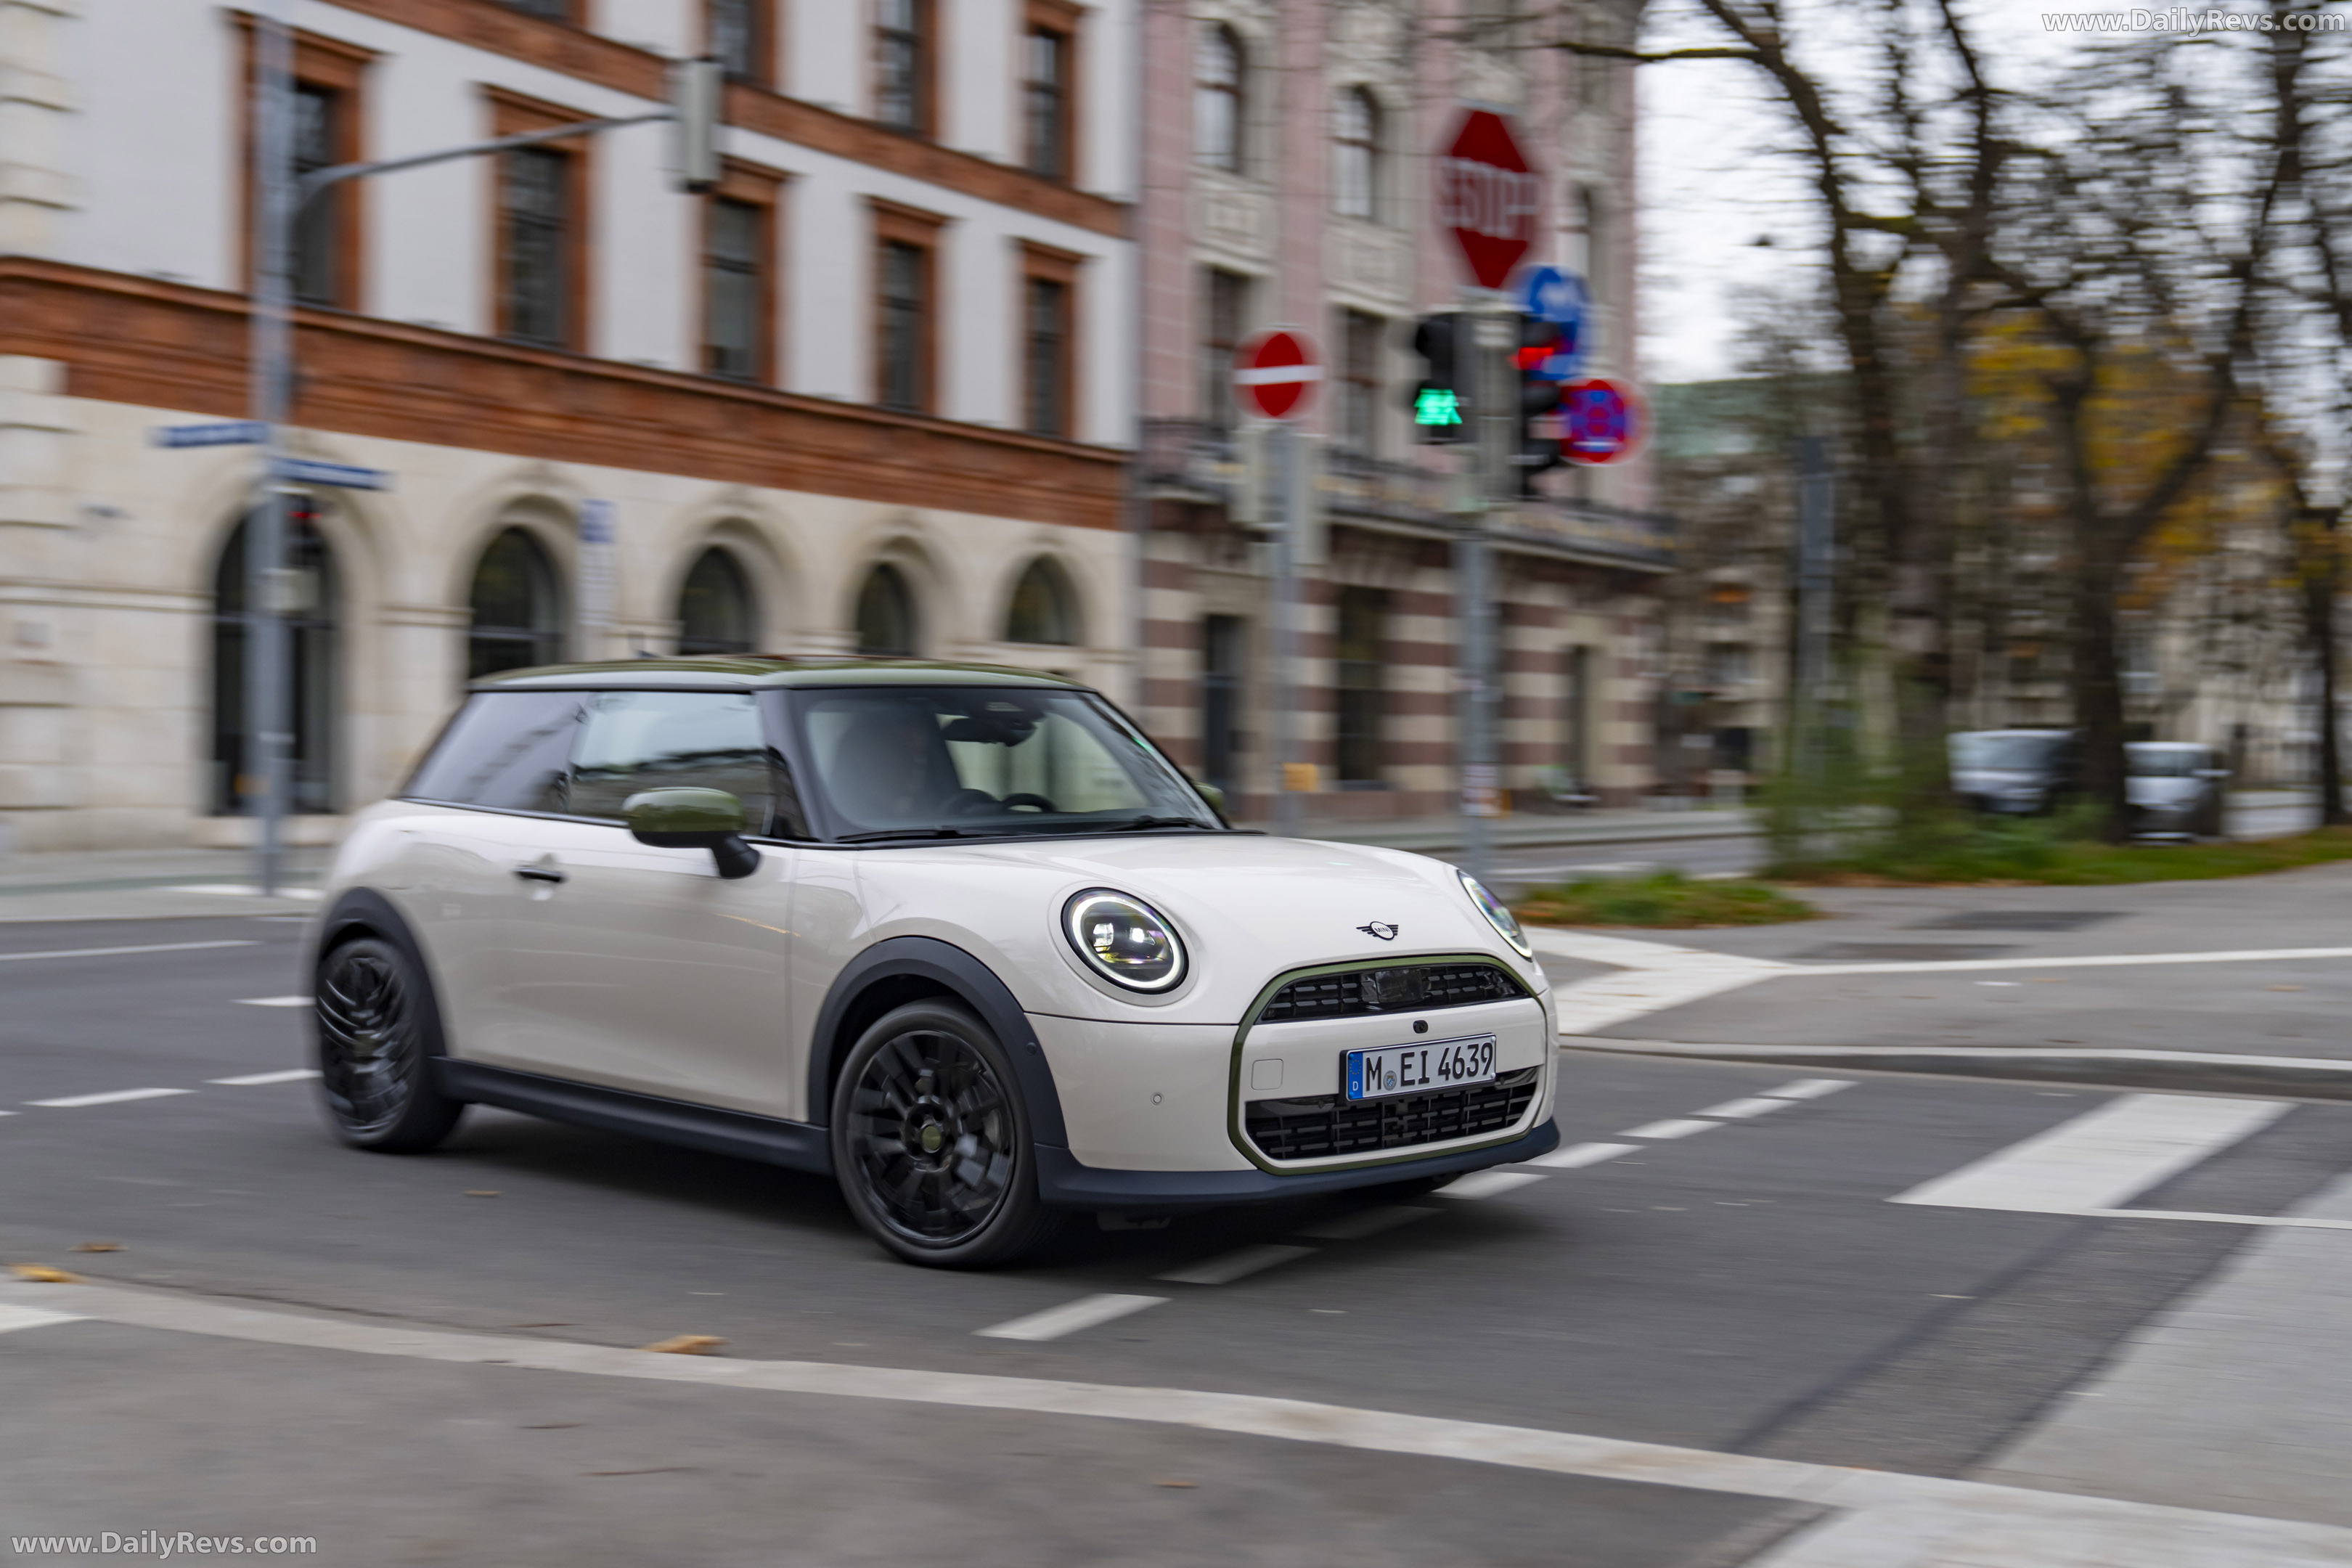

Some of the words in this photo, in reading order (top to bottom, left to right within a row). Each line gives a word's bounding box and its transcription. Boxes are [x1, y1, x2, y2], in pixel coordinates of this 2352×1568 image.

[1365, 1055, 1382, 1091] M
[1400, 1050, 1430, 1087] EI
[1438, 1042, 1493, 1081] 4639
[1352, 1081, 1359, 1091] D
